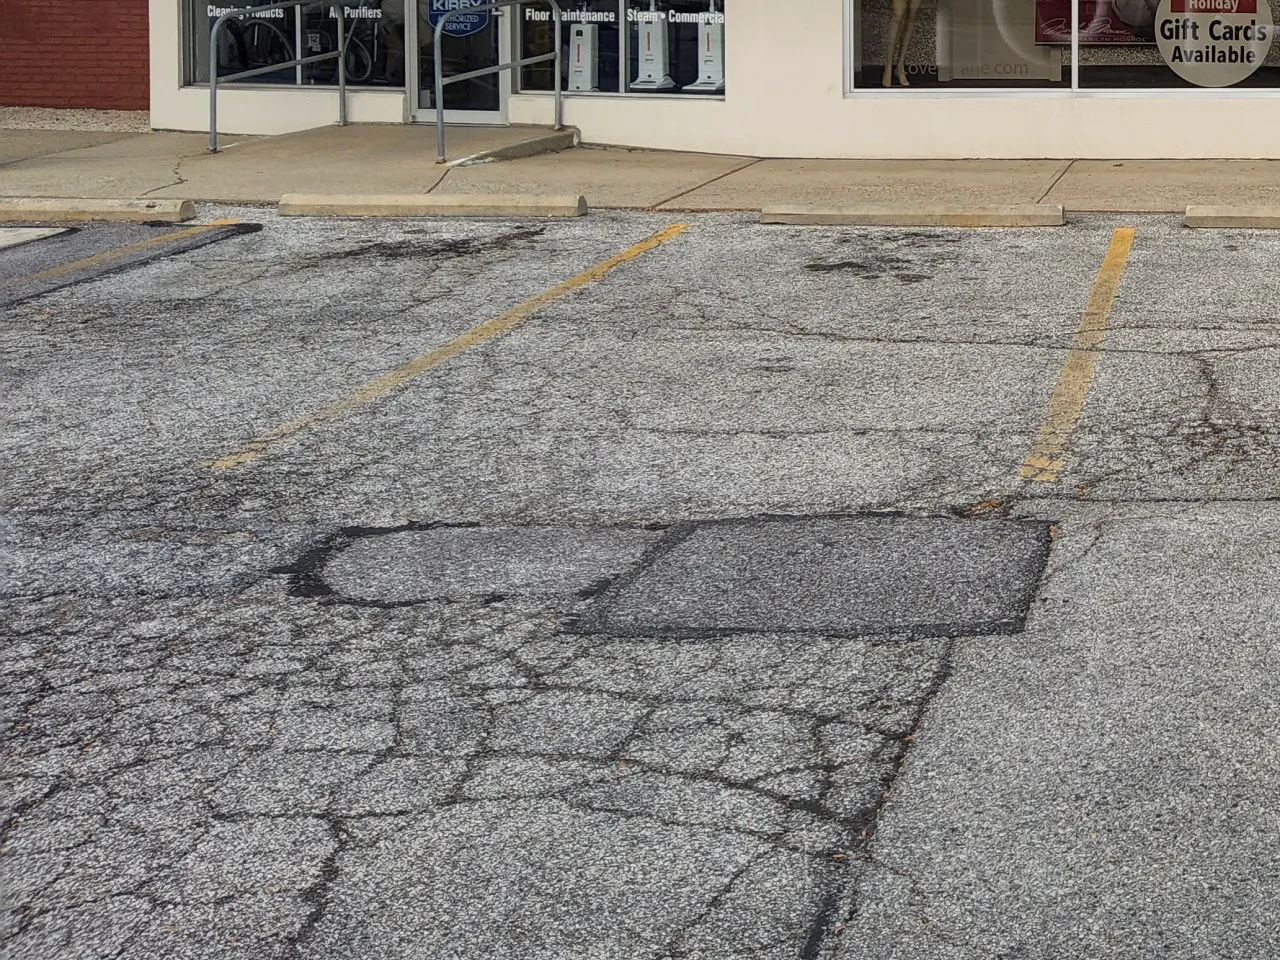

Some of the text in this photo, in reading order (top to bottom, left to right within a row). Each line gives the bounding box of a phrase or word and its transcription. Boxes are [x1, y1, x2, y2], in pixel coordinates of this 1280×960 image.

[207, 4, 244, 20] Cleani
[344, 5, 382, 19] Purifiers
[432, 0, 483, 10] KIRBY
[525, 8, 615, 22] Floor aintenance
[627, 8, 725, 24] Steam Commercia
[1160, 18, 1267, 42] Gift Cards
[1171, 45, 1256, 64] Available
